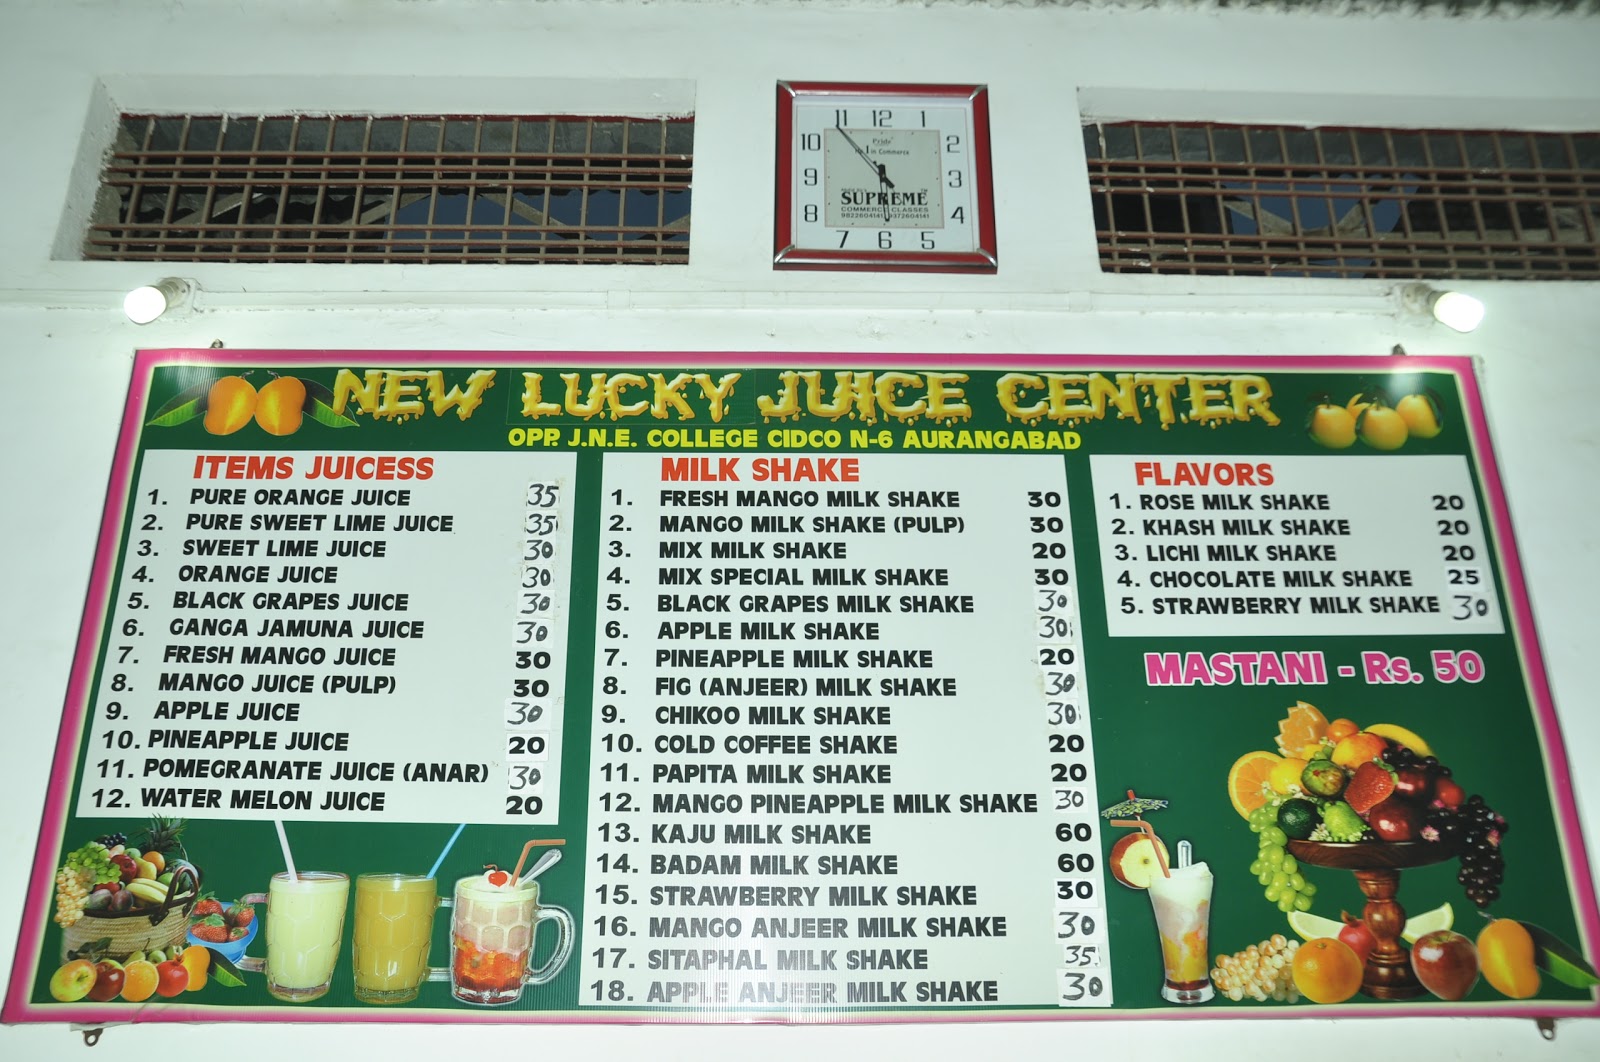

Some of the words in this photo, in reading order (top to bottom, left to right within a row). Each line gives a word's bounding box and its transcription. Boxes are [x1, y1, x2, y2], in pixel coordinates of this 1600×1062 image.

[835, 109, 847, 126] 11
[872, 110, 893, 128] 12
[921, 111, 926, 128] 1
[801, 133, 821, 151] 10
[946, 135, 960, 153] 2
[804, 168, 818, 186] 9
[948, 170, 962, 188] 3
[804, 204, 818, 222] 8
[951, 206, 964, 224] 4
[836, 230, 849, 248] 7
[878, 231, 892, 249] 6
[921, 231, 935, 250] 5
[333, 369, 497, 423] NEW
[521, 372, 742, 423] LUCKY
[756, 370, 972, 427] JUICE
[996, 372, 1281, 429] CENTER
[568, 428, 637, 447] J.N.E.
[647, 429, 758, 448] COLLEGE
[767, 430, 841, 448] CIDCO
[850, 430, 893, 448] N-6
[902, 430, 1082, 450] AURANGABAD
[193, 455, 294, 480] ITEMS
[305, 456, 434, 480] JUICESS
[661, 457, 740, 482] MILK
[752, 457, 859, 482] SHAKE
[1135, 462, 1274, 487] FLAVORS
[189, 488, 247, 505] PURE
[253, 488, 344, 506] ORANGE
[350, 489, 411, 507] JUICE
[527, 483, 559, 508] 35
[660, 489, 729, 507] FRESH
[736, 490, 819, 508] MANGO
[826, 490, 881, 508] MILK
[887, 490, 960, 508] SHAKE
[1027, 491, 1061, 508] 30
[1139, 493, 1195, 511] ROSE
[1201, 493, 1254, 511] MILK
[1260, 494, 1331, 511] SHAKE
[1432, 495, 1464, 511] 20
[185, 513, 244, 531] PURE
[249, 514, 328, 531] SWEET
[333, 514, 386, 532] LIME
[393, 514, 454, 532] JUICE
[659, 515, 744, 533] MANGO
[750, 515, 805, 533] MILK
[812, 515, 886, 534] SHAKE
[893, 516, 965, 534] (PULP)
[1030, 517, 1064, 533] 30
[1142, 519, 1216, 536] KHASH
[1221, 519, 1274, 536] MILK
[1280, 519, 1351, 536] SHAKE
[1437, 520, 1470, 536] 20
[182, 538, 260, 557] SWEET
[266, 539, 319, 557] LIME
[325, 540, 387, 558] JUICE
[524, 539, 554, 561] 30
[659, 541, 703, 559] MIX
[710, 541, 765, 559] MILK
[772, 541, 847, 560] SHAKE
[1032, 542, 1066, 559] 20
[1146, 544, 1200, 562] LICHI
[1206, 544, 1260, 562] MILK
[1266, 544, 1337, 562] SHAKE
[1443, 545, 1475, 562] 20
[658, 567, 703, 586] MIX
[710, 567, 804, 586] SPECIAL
[812, 568, 867, 586] MILK
[874, 568, 949, 586] SHAKE
[1034, 568, 1069, 586] 30
[1149, 570, 1276, 588] CHOCOLATE
[1282, 570, 1336, 588] MILK
[1341, 570, 1413, 588] SHAKE
[1448, 569, 1480, 586] 25
[172, 590, 246, 610] BLACK
[252, 592, 340, 611] GRAPES
[347, 593, 409, 612] JUICE
[657, 594, 731, 613] BLACK
[739, 594, 829, 613] GRAPES
[836, 595, 892, 613] MILK
[899, 595, 975, 614] SHAKE
[1038, 589, 1068, 612] 30
[1152, 597, 1302, 615] STRAWBERRY
[1309, 596, 1363, 614] MILK
[1369, 595, 1441, 614] SHAKE
[1452, 595, 1488, 620] 30
[169, 617, 249, 637] GANGA
[256, 619, 354, 638] JAMUNA
[362, 620, 425, 639] JUICE
[516, 621, 548, 644] 30
[162, 644, 235, 664] FRESH
[240, 646, 326, 666] MANGO
[333, 647, 396, 667] JUICE
[515, 651, 551, 669] 30
[655, 649, 785, 668] PINEAPPLE
[793, 649, 850, 668] MILK
[856, 649, 933, 669] SHAKE
[1039, 648, 1075, 666] 20
[1144, 652, 1327, 687] MASTANI
[1362, 651, 1424, 685] Rs.
[1432, 650, 1486, 684] 50
[158, 672, 245, 692] MANGO
[251, 674, 315, 694] JUICE
[322, 675, 396, 695] (PULP)
[513, 679, 550, 698] 30
[655, 676, 691, 696] FIG
[699, 677, 808, 697] (ANJEER)
[815, 677, 873, 697] MILK
[879, 677, 957, 697] SHAKE
[1045, 671, 1075, 696] 30
[153, 700, 230, 721] APPLE
[236, 702, 301, 722] JUICE
[507, 701, 543, 725] 30
[147, 729, 278, 751] PINEAPPLE
[284, 731, 350, 752] JUICE
[508, 736, 545, 755] 20
[142, 758, 323, 781] POMEGRANATE
[329, 761, 395, 782] JUICE
[403, 762, 489, 783] (ANAR)
[140, 787, 223, 809] WATER
[229, 789, 313, 810] MELON
[319, 791, 386, 812] JUICE
[505, 795, 543, 815] 20
[652, 793, 743, 814] MANGO
[750, 794, 885, 814] PINEAPPLE
[893, 793, 952, 814] MILK
[959, 793, 1038, 814] SHAKE
[1055, 789, 1084, 810] 30
[650, 885, 820, 907] STRAWBERRY
[828, 885, 889, 907] MILK
[896, 885, 977, 906] SHAKE
[1057, 881, 1094, 900] 30
[646, 981, 729, 1004] APPLE
[738, 982, 838, 1004] ANJEER
[847, 981, 908, 1003] MILK
[915, 980, 999, 1003] SHAKE
[1062, 972, 1103, 1001] 30
